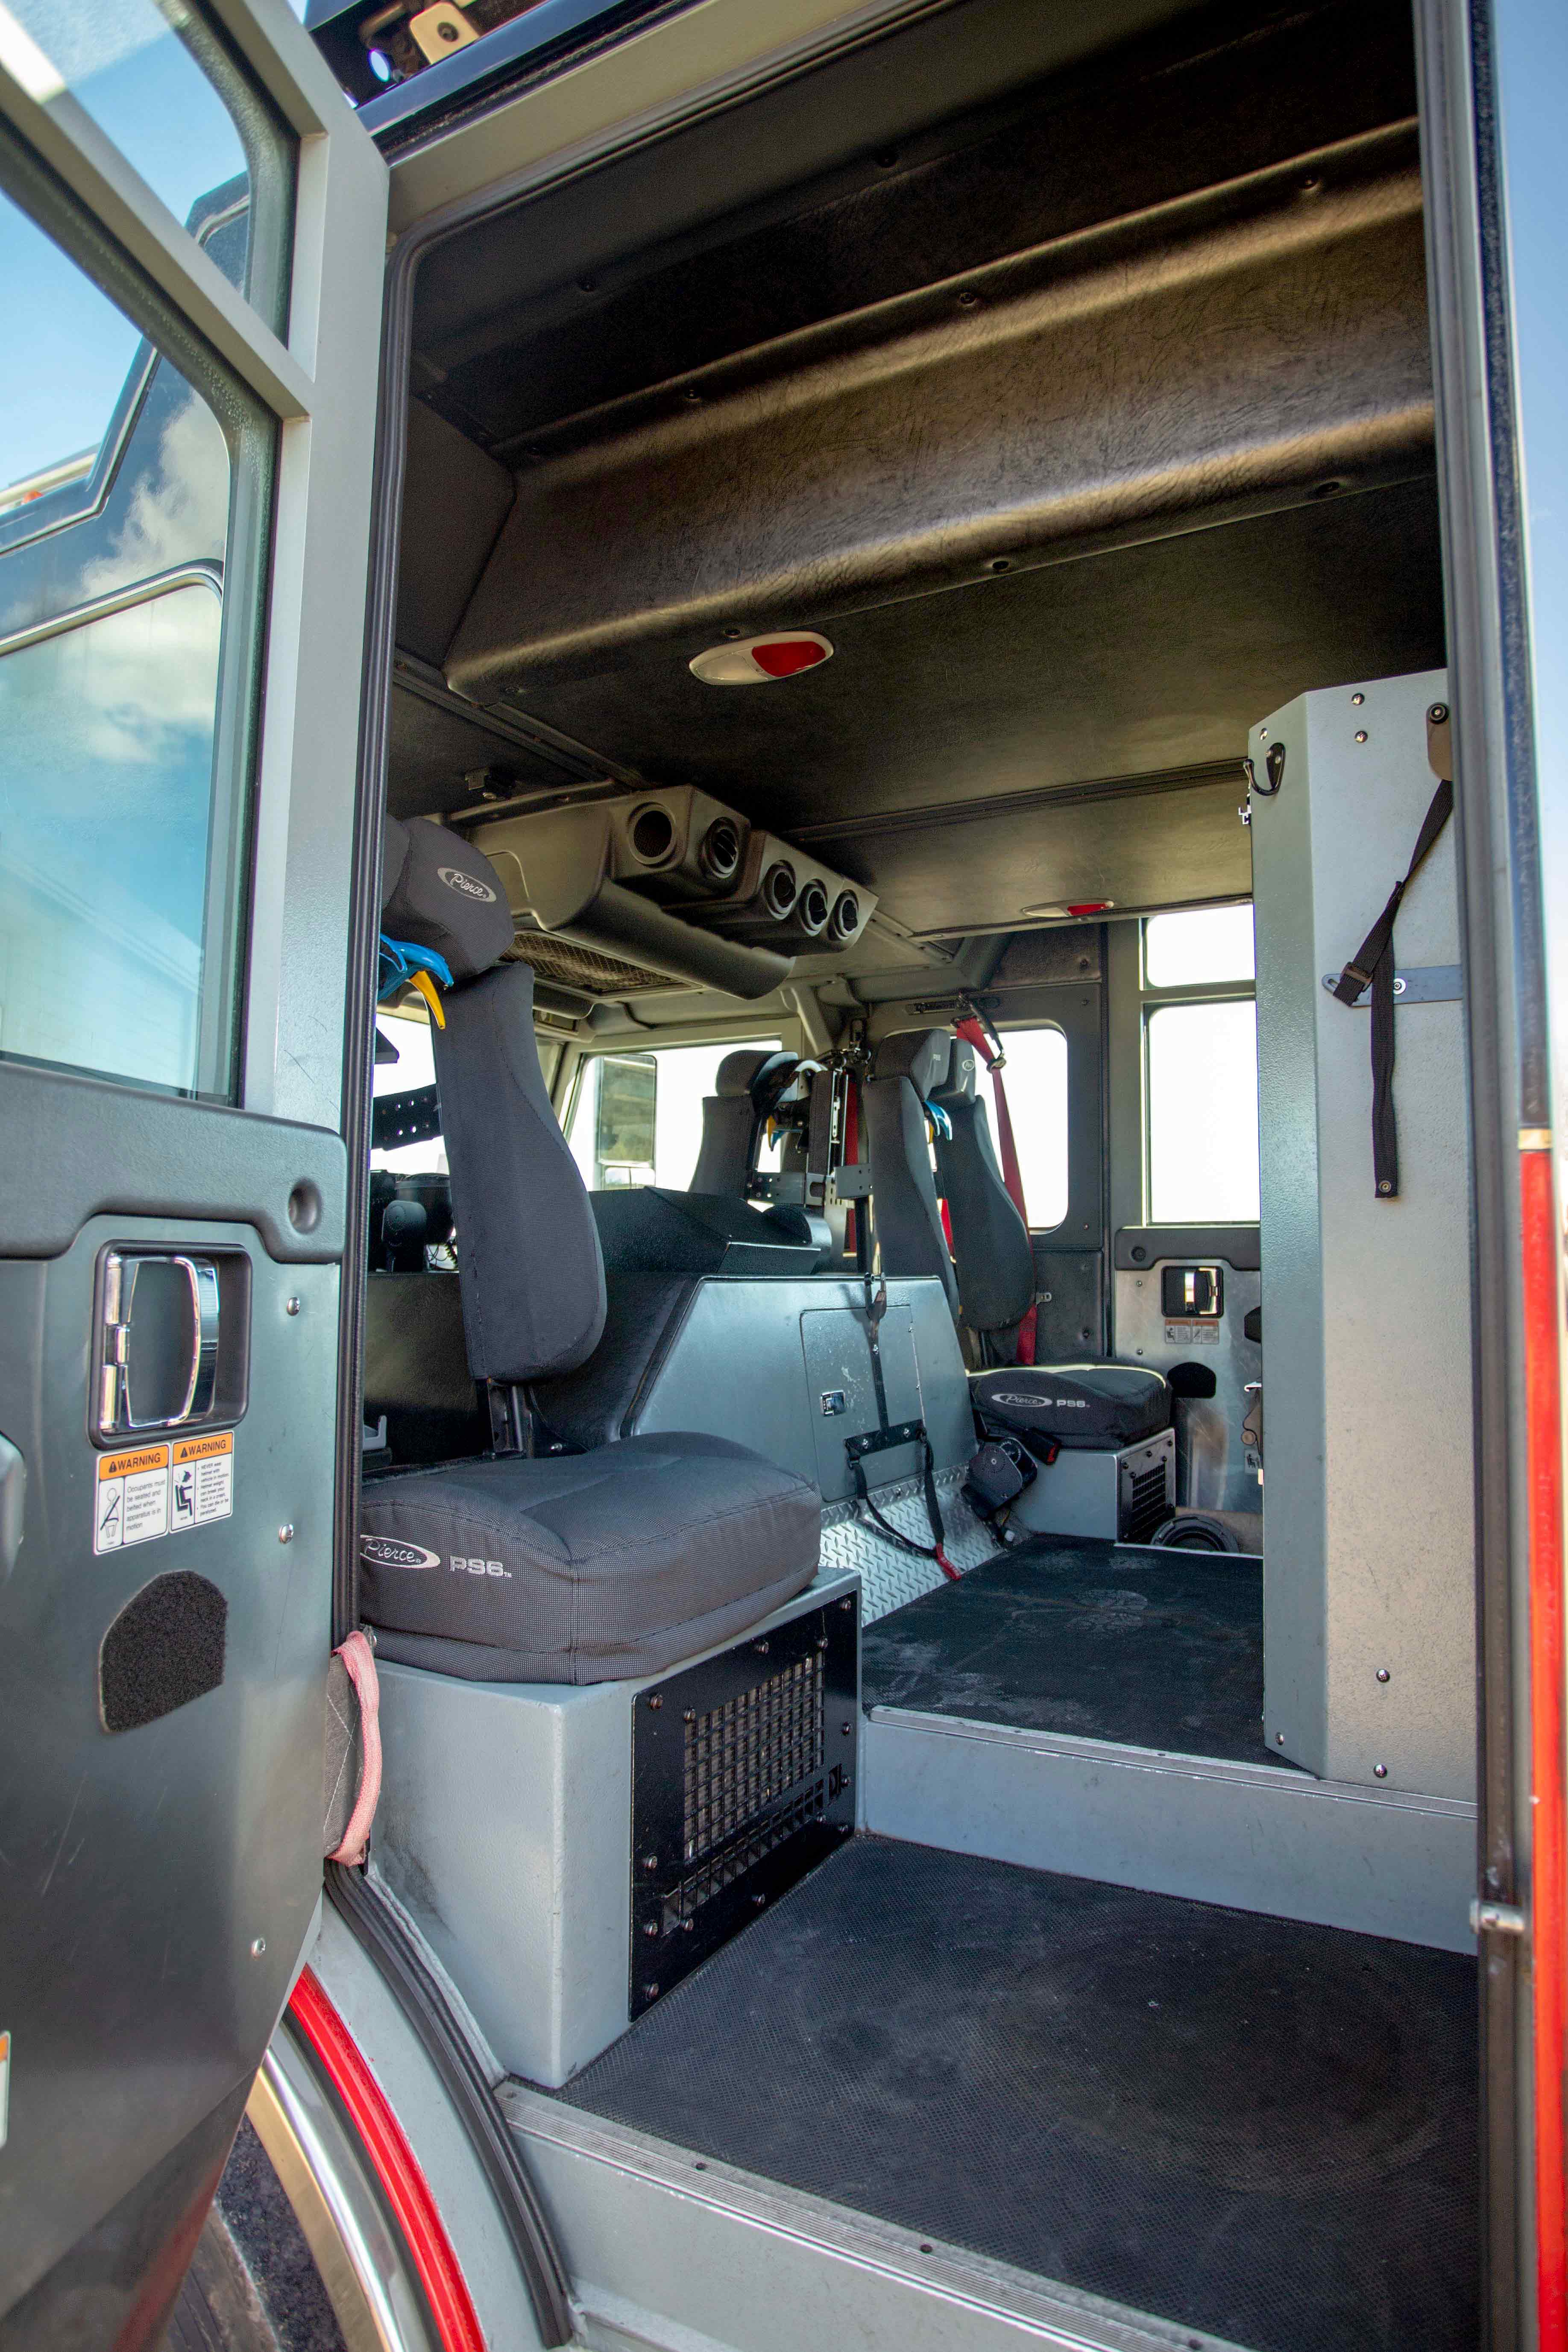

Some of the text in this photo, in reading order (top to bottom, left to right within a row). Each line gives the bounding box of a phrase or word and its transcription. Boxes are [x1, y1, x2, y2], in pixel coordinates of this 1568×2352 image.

[450, 873, 484, 896] Pierce
[1006, 1395, 1038, 1405] Pierce
[188, 1439, 226, 1456] WARNING
[117, 1453, 161, 1470] WARNING
[135, 1492, 150, 1500] seated
[365, 1538, 415, 1563] Pierce
